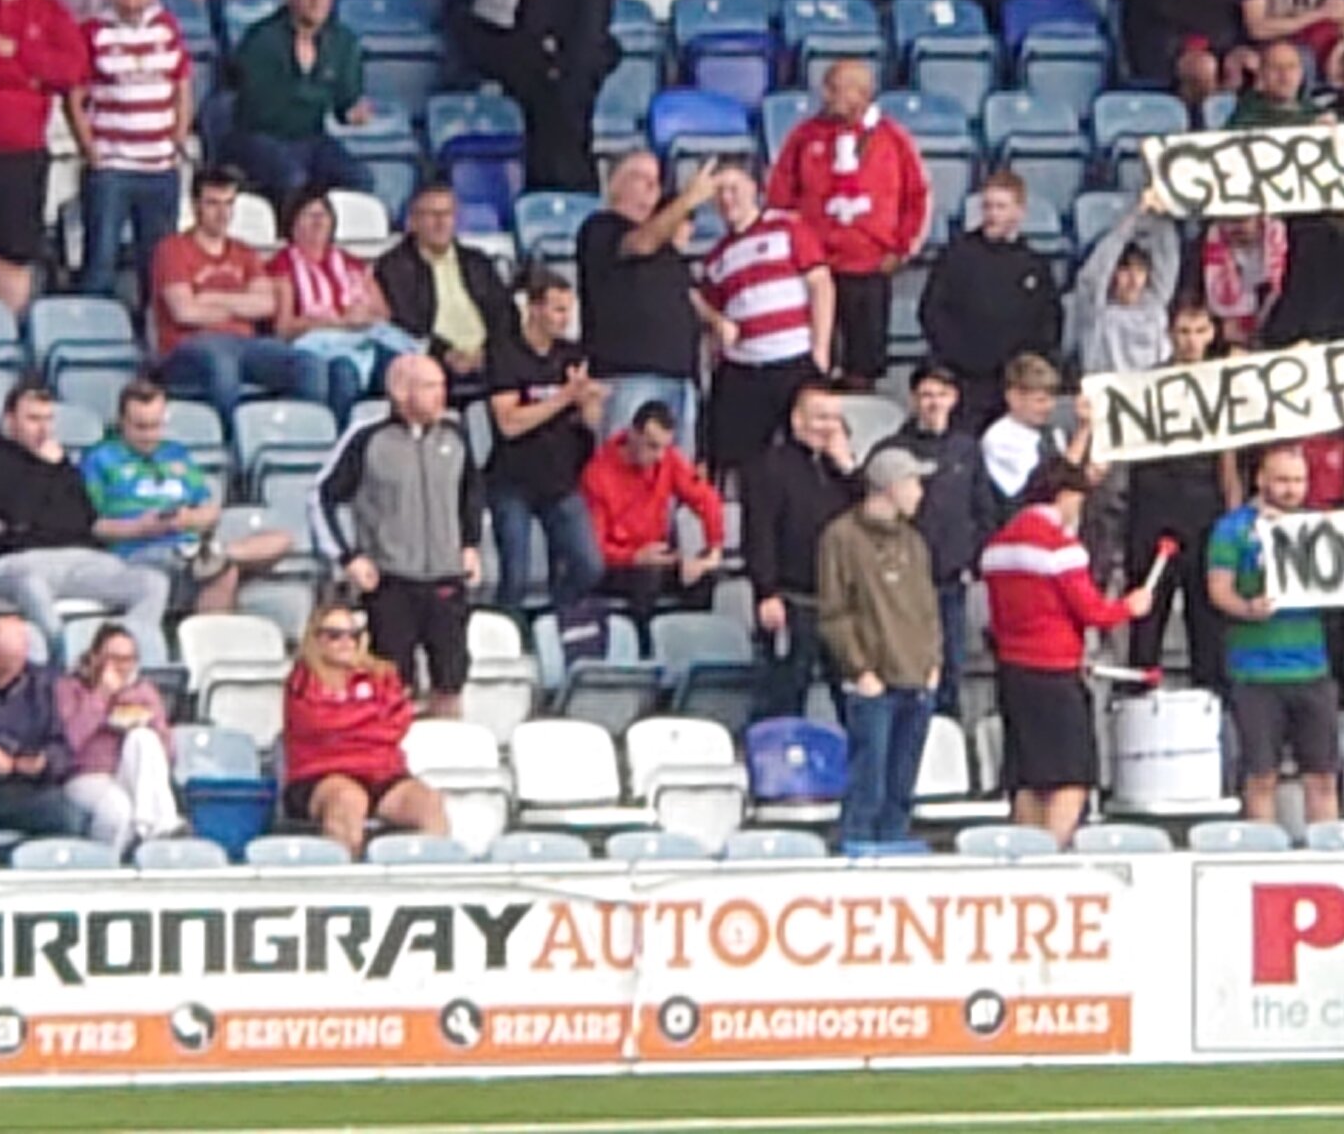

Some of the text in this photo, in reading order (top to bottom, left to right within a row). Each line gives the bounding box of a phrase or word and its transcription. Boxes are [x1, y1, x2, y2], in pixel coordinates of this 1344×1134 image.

[1105, 357, 1311, 447] NEVER
[34, 1003, 1110, 1055] TYRES SERVICING REPAIRS DIAGNOSTICS SALES
[1252, 996, 1309, 1028] the
